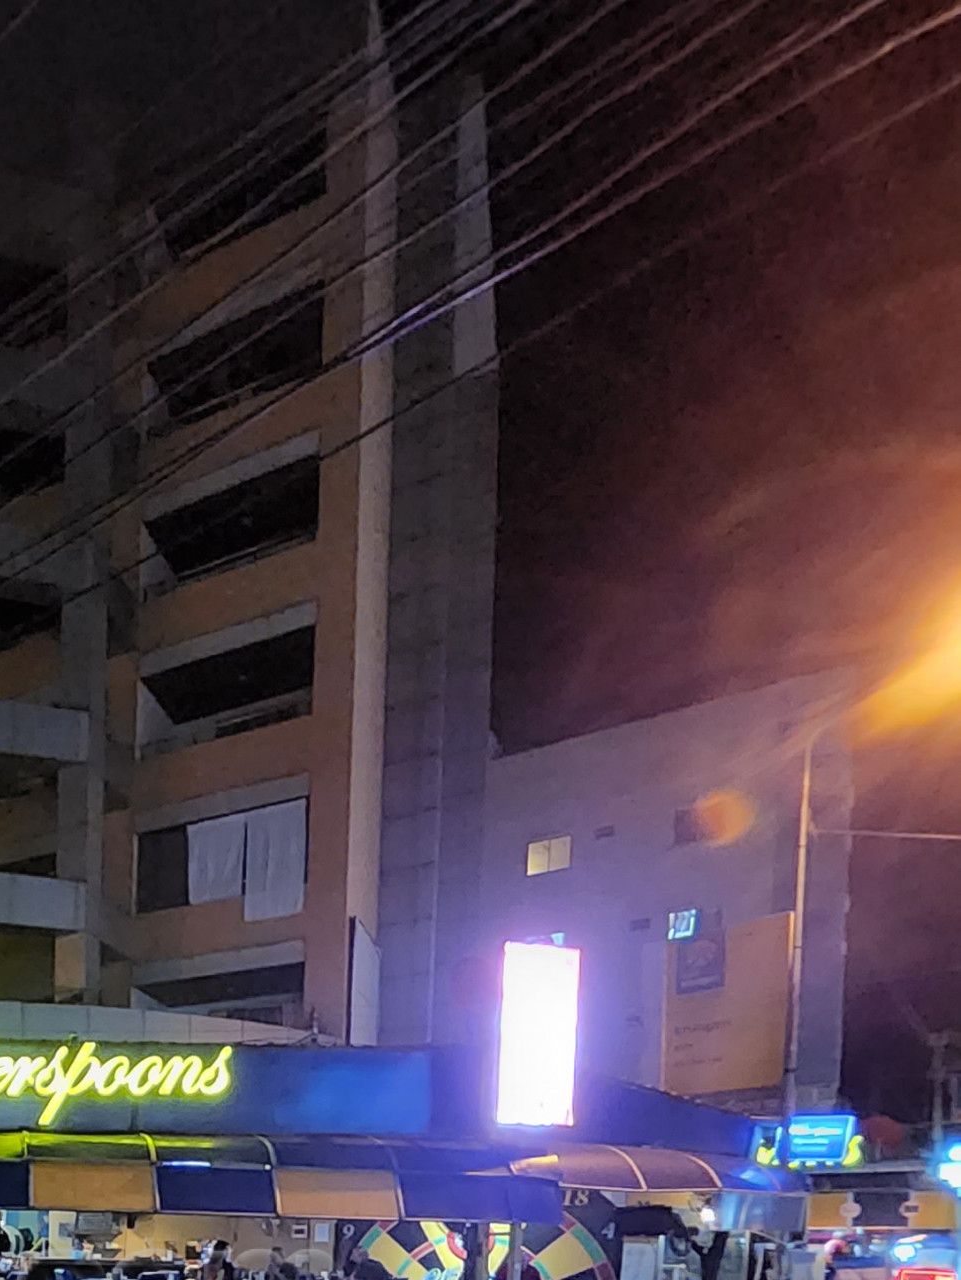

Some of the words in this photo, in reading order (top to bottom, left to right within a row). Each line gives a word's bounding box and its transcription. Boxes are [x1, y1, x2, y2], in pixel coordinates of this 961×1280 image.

[562, 1189, 590, 1207] 18
[342, 1224, 356, 1241] 9
[601, 1222, 616, 1240] 4
